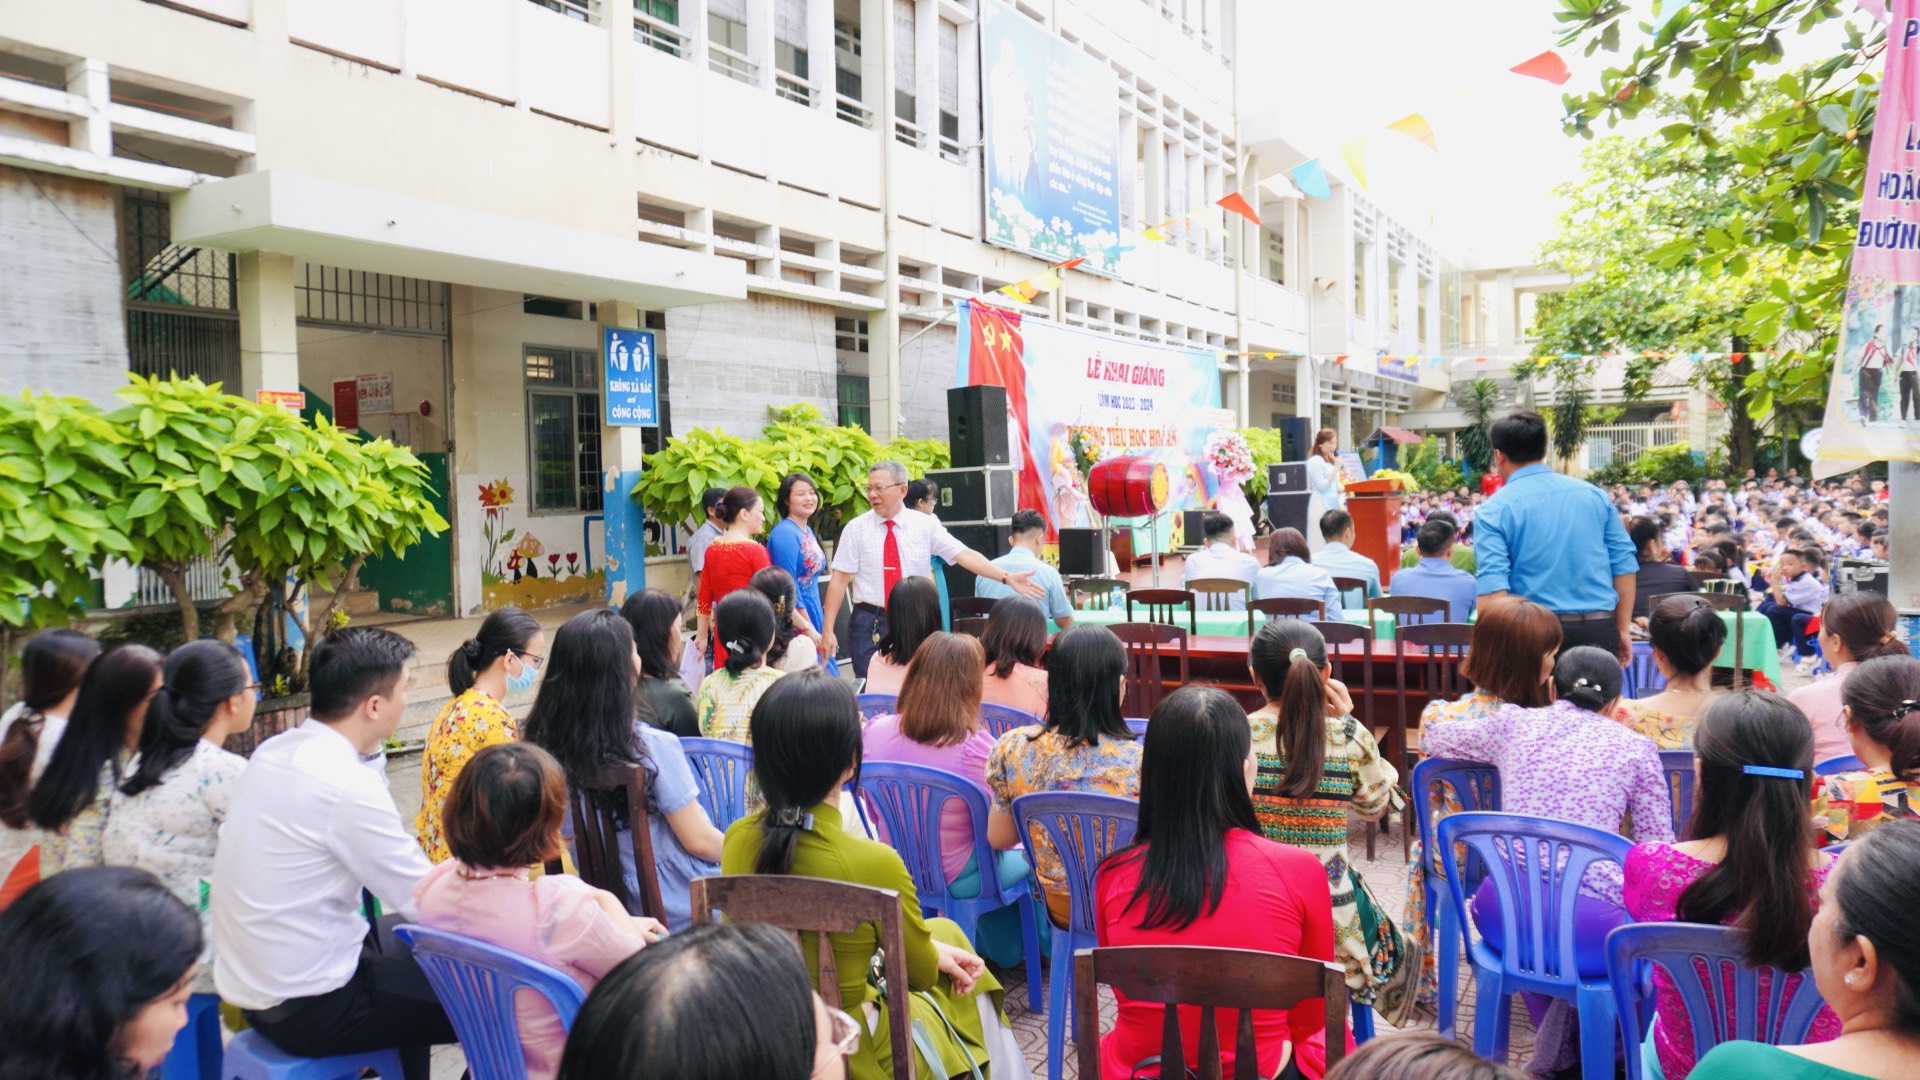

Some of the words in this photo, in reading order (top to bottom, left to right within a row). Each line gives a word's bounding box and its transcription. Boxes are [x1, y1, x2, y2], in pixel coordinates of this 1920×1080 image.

[1104, 361, 1130, 384] KHAI
[610, 378, 631, 392] KHÔNG
[640, 380, 652, 394] RÁC
[1140, 398, 1153, 411] 2024
[612, 405, 631, 418] CÔNG
[633, 405, 651, 421] CỘNG
